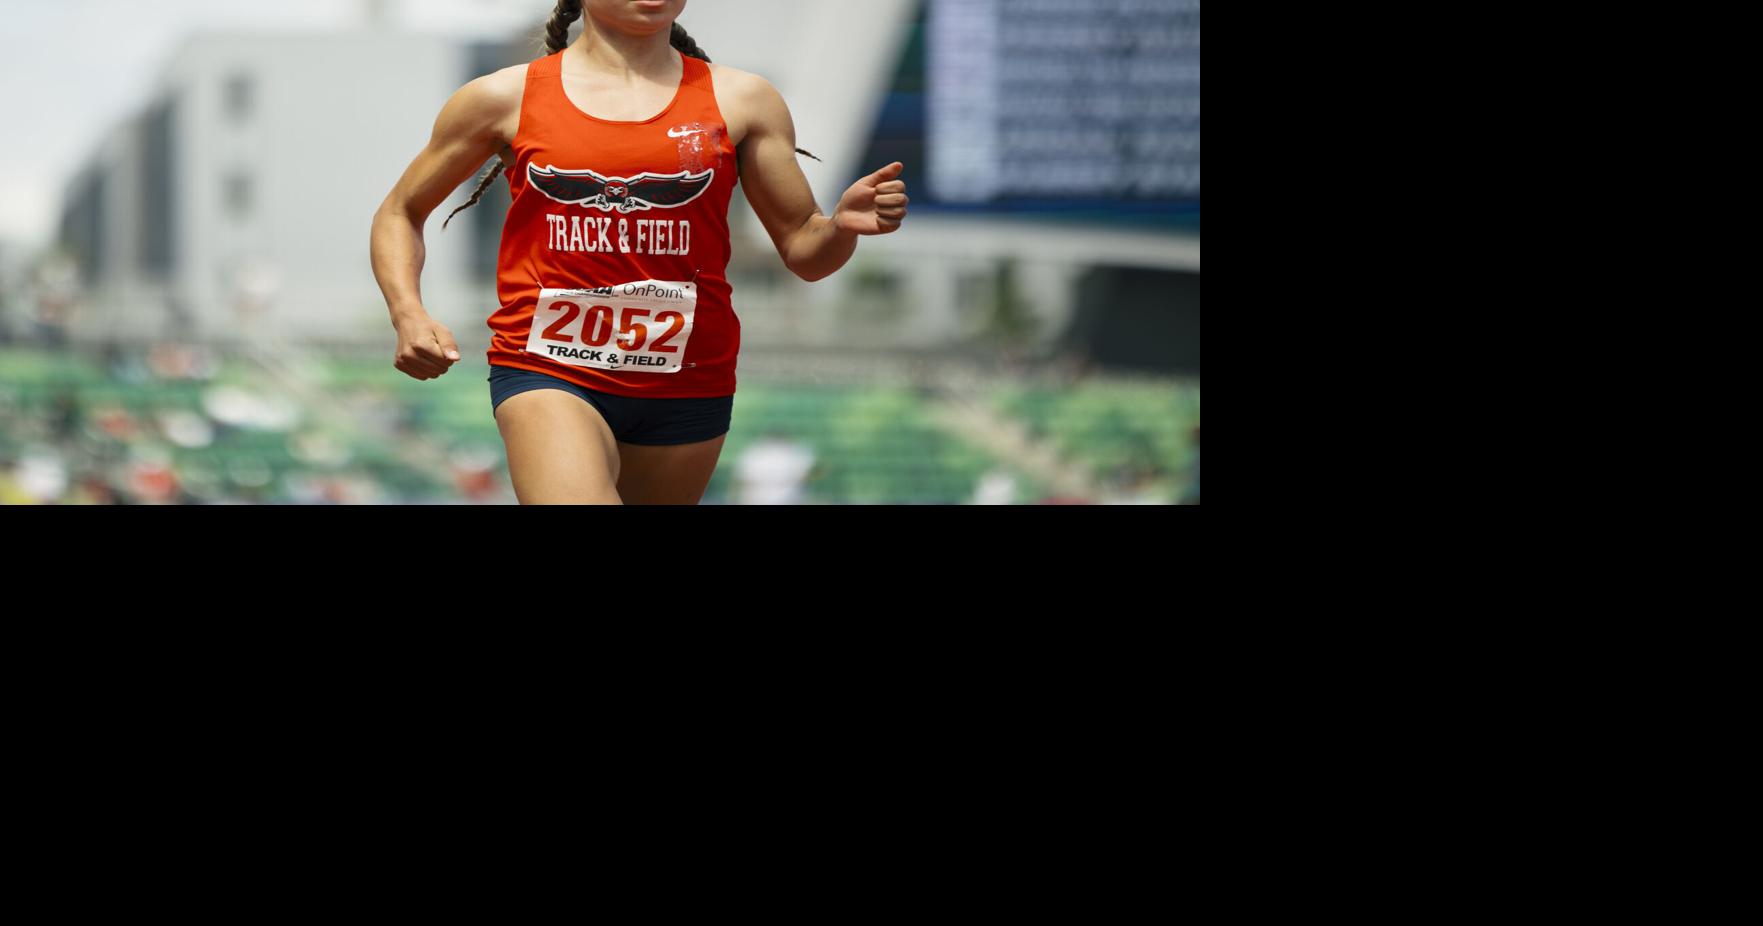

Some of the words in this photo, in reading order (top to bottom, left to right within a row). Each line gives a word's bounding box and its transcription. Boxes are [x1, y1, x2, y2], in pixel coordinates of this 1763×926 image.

[546, 214, 614, 253] TRACK
[618, 217, 630, 252] &
[636, 218, 690, 256] FIELD
[623, 283, 684, 299] OnPoint
[541, 300, 686, 353] 2052
[547, 345, 603, 361] TRACK
[607, 354, 619, 364] &
[623, 355, 667, 366] FIELD
